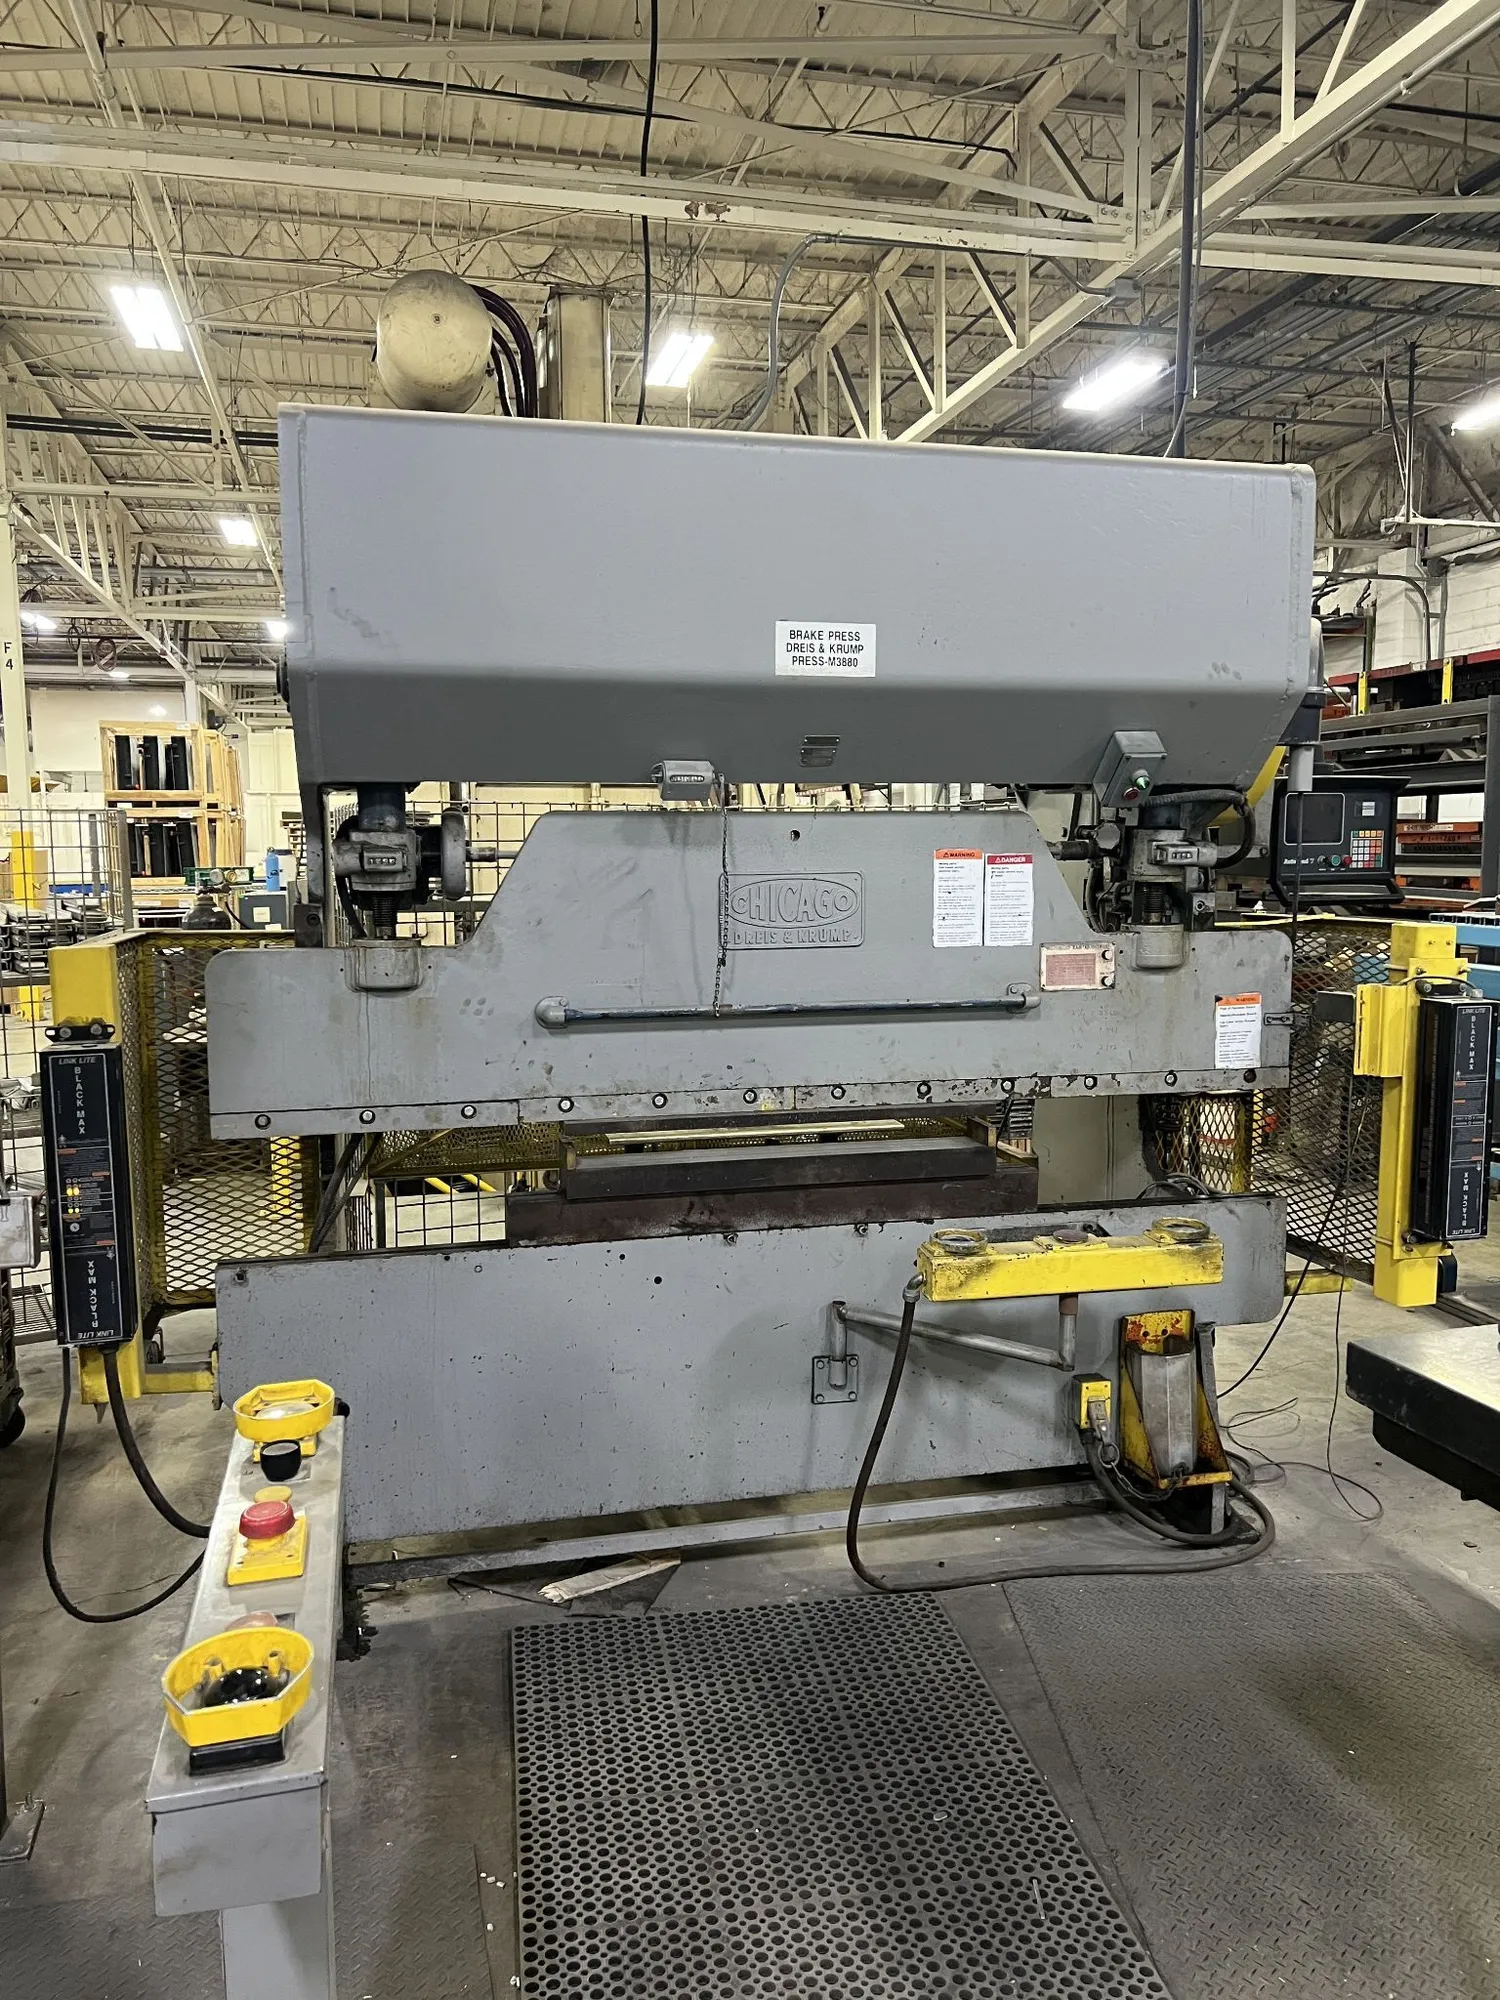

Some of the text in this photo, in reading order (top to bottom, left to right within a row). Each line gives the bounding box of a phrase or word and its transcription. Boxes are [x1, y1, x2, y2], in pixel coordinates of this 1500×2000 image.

[789, 629, 861, 642] BRAKE PRESS
[4, 642, 12, 654] F
[786, 642, 864, 654] DREIS & KRUMP
[5, 658, 13, 670] 4
[791, 655, 859, 668] PRESS-M3880
[731, 882, 854, 923] CHICAGO
[733, 928, 851, 945] DREIS & KRUMP
[58, 1056, 97, 1065] LINK LITE
[74, 1066, 86, 1135] BLACK MAX
[87, 1260, 99, 1328] BLACK MAX
[77, 1329, 114, 1340] LINK LITE
